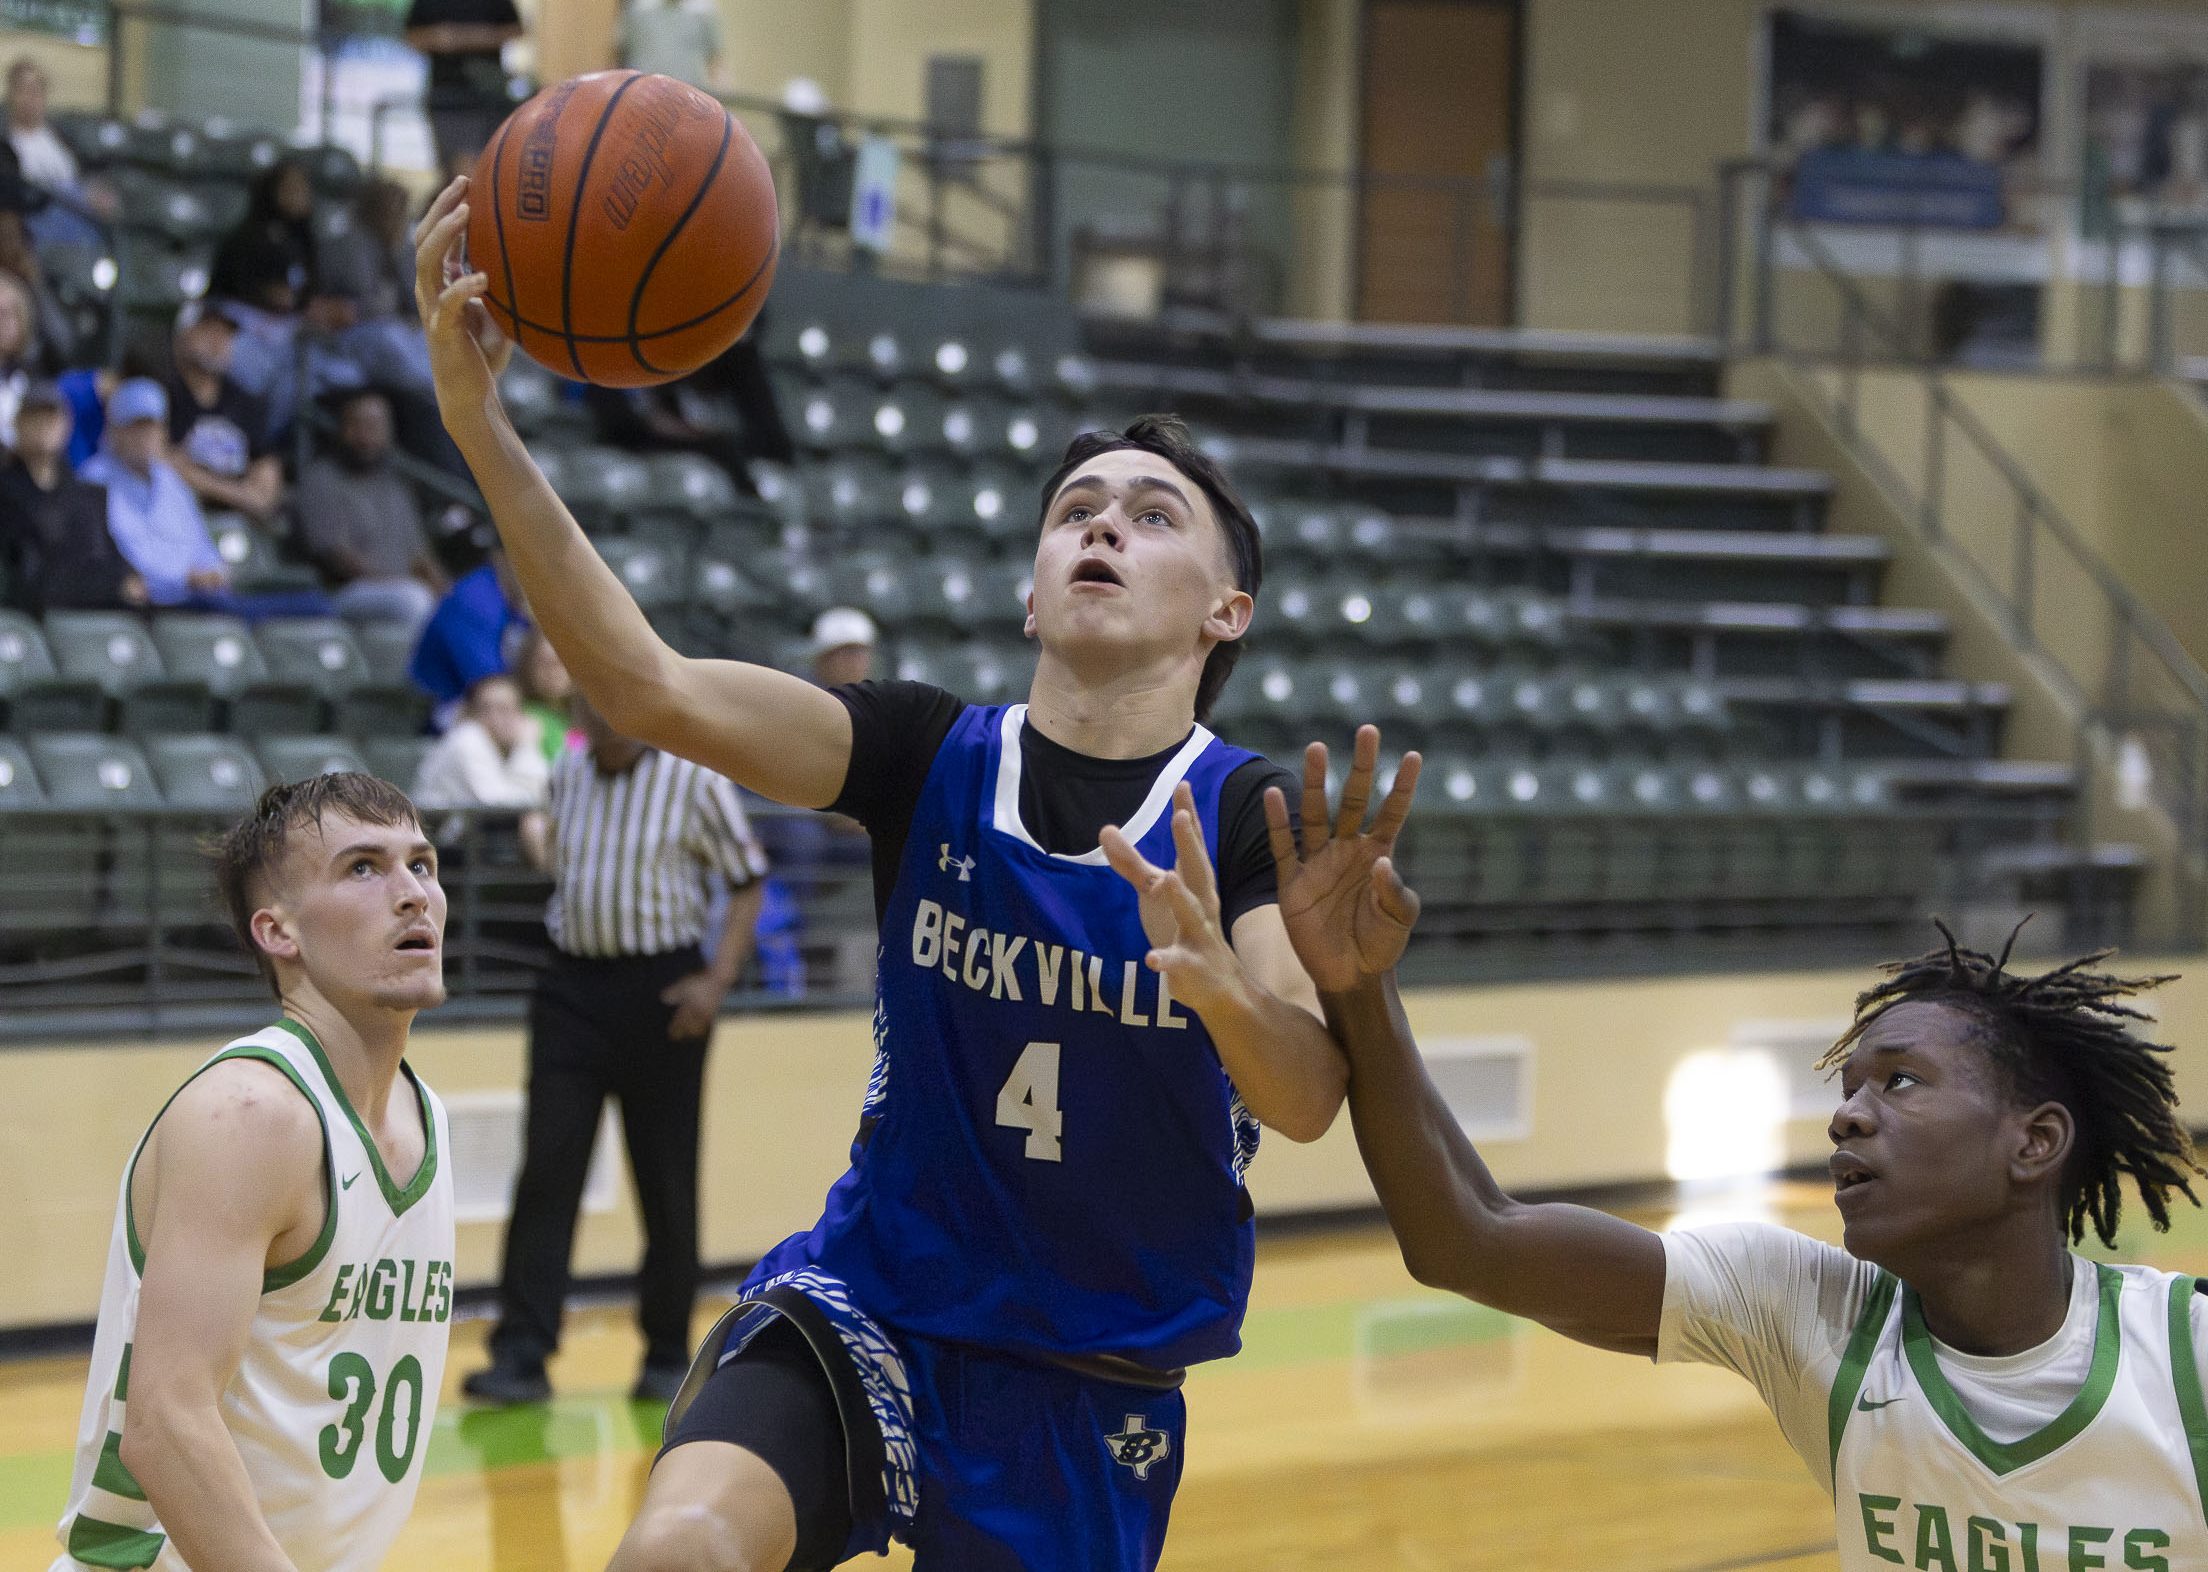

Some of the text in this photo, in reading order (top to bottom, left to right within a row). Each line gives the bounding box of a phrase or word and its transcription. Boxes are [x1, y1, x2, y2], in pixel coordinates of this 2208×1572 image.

[521, 148, 551, 216] PRO
[995, 1041, 1063, 1163] 4
[318, 1258, 452, 1323] EAGLES
[318, 1351, 424, 1485] 30
[1858, 1492, 2171, 1572] EAGLES
